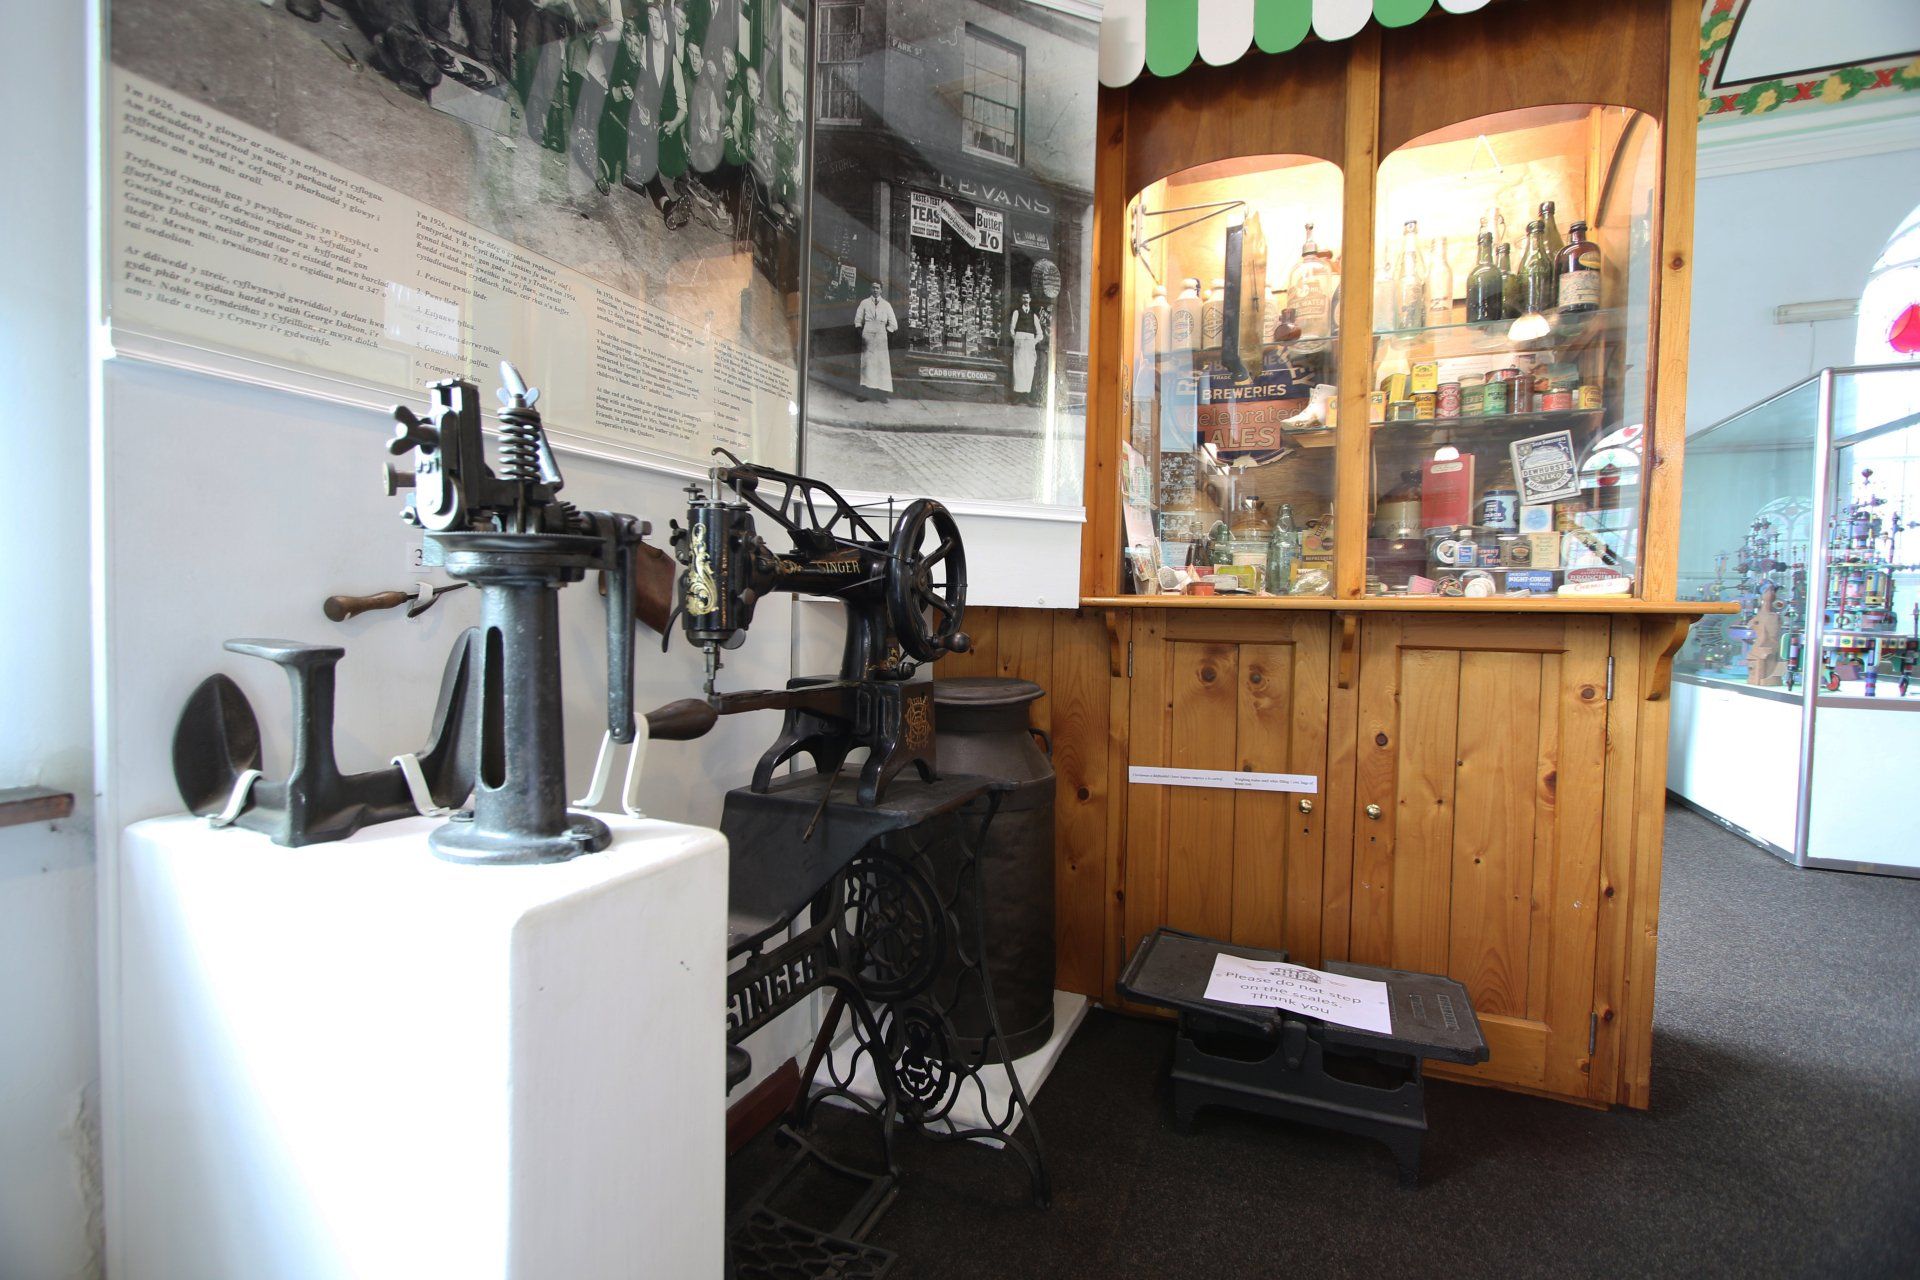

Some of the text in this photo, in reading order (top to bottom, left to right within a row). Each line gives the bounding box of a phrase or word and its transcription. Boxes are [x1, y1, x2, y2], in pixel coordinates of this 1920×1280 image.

[122, 122, 167, 148] frwydro
[172, 144, 187, 155] am
[192, 153, 214, 166] wyth
[218, 163, 235, 174] mis
[124, 83, 142, 99] Ym
[180, 110, 201, 124] aeth
[205, 121, 210, 130] y
[215, 125, 247, 144] glowyr
[250, 140, 260, 149] ar
[264, 146, 287, 161] streic
[290, 157, 300, 166] yn
[304, 164, 326, 178] erbyn
[330, 173, 347, 186] torri
[124, 96, 366, 205] Am ddeuddeng niwrnod yn unig y parhaodd streic
[124, 112, 184, 142] gyffredinol
[198, 142, 226, 159] alwyd
[294, 182, 340, 205] pharhaodd
[349, 204, 374, 219] glowyr
[122, 163, 355, 255] ffurfwyd cydweithfa drwsio esgidiau yn Sefydliad
[124, 150, 176, 177] Trefnwyd
[180, 174, 221, 194] cymorth
[224, 190, 242, 202] gan
[254, 201, 292, 220] pwyllgor
[295, 217, 317, 230] streic
[320, 226, 330, 235] yn
[958, 180, 1050, 214] EVANS
[124, 220, 140, 230] rai
[911, 204, 941, 224] TEAS
[976, 213, 1002, 232] Butter
[124, 189, 164, 211] George
[215, 224, 244, 238] meistr
[246, 234, 273, 248] grydd
[292, 249, 299, 257] ei
[336, 265, 358, 277] mewn
[219, 213, 260, 232] cryddion
[263, 229, 295, 245] amatur
[297, 241, 308, 249] eu
[314, 245, 350, 264] hyfforddi
[353, 261, 367, 270] gan
[162, 216, 193, 234] Mewn
[222, 238, 269, 259] trwsiasant
[273, 254, 288, 265] 782
[299, 265, 333, 280] esgidiau
[336, 276, 356, 288] plant
[366, 284, 379, 295] 347
[124, 243, 138, 256] Ar
[143, 249, 187, 270] ddiwedd
[232, 279, 285, 300] cyflwynwyd
[288, 295, 331, 312] gwreiddiol
[341, 309, 366, 323] darlun
[124, 259, 151, 272] gyda
[193, 280, 235, 296] esgidiau
[238, 290, 265, 305] hardd
[278, 304, 300, 315] waith
[303, 309, 333, 325] George
[966, 371, 988, 379] COCOA
[1202, 384, 1287, 400] BREWERIES
[1187, 405, 1301, 432] Celebrated
[1211, 427, 1276, 448] ALES
[415, 550, 422, 566] 3
[817, 560, 860, 574] SINGER
[1225, 971, 1362, 1004] Please do not step
[1250, 992, 1330, 1015] Thank you
[1264, 984, 1289, 995] the
[1292, 990, 1343, 1009] scales.
